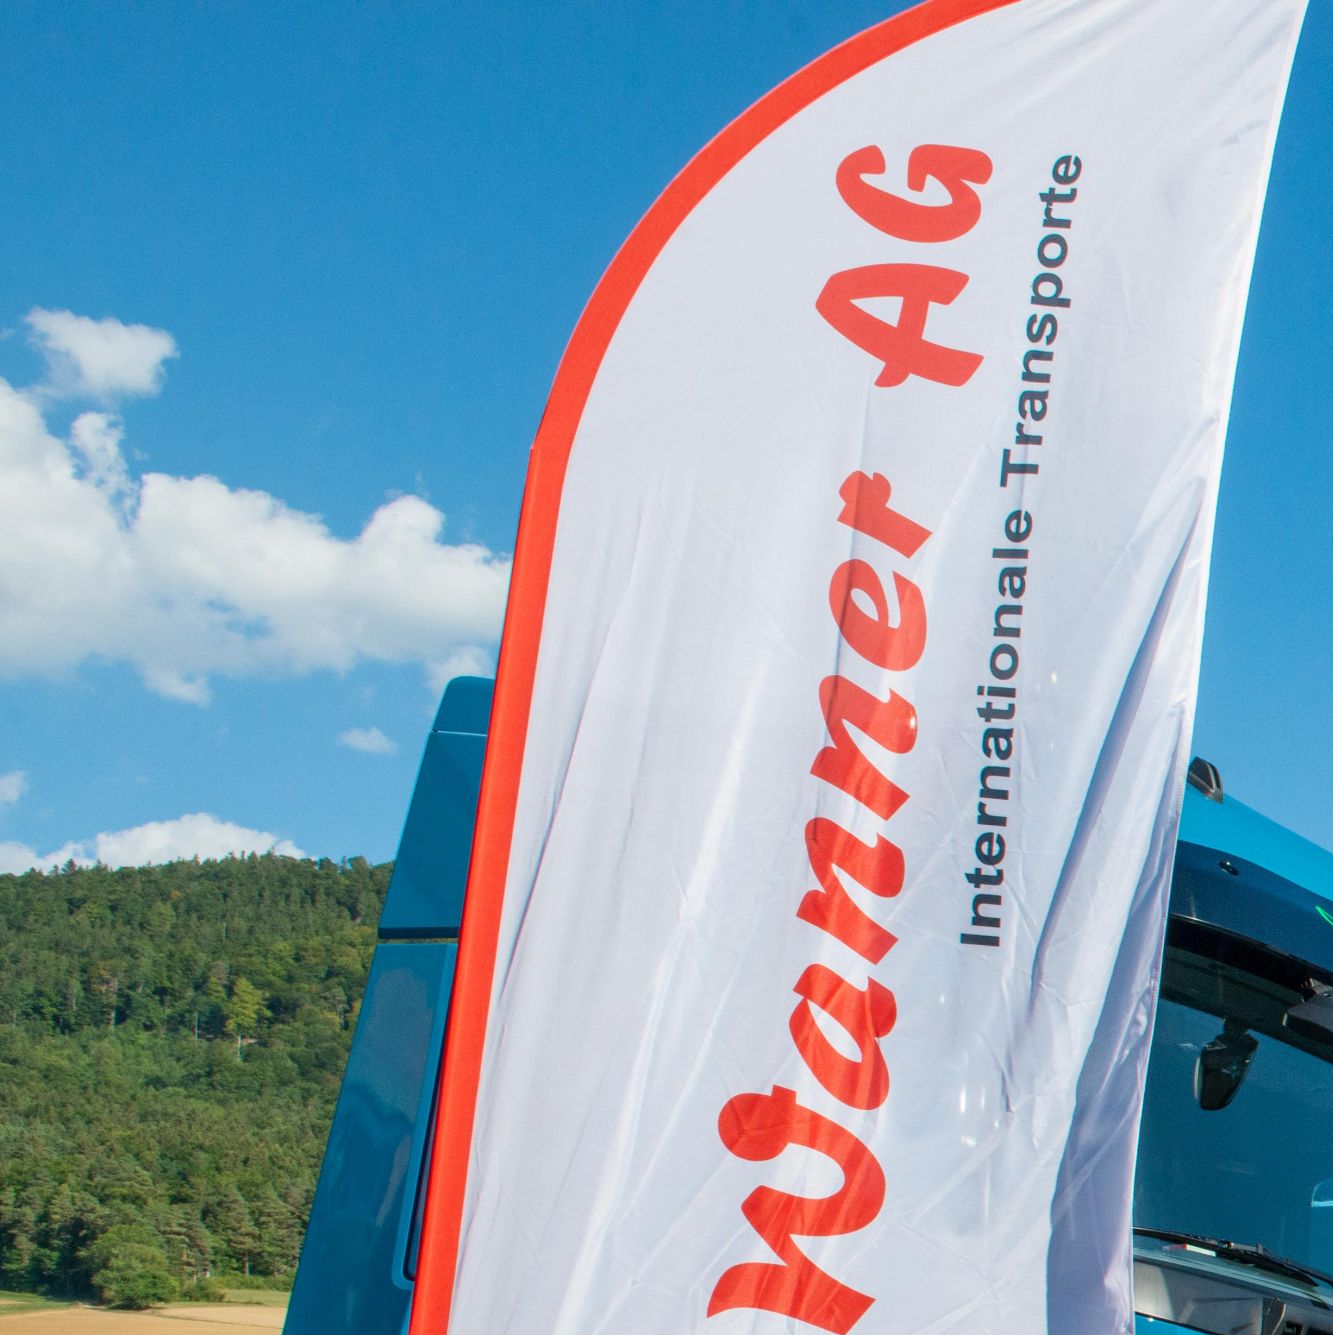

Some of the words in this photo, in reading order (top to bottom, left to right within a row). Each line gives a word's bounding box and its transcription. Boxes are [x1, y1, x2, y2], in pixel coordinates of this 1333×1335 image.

[815, 143, 993, 388] AG
[960, 509, 1032, 947] Internationale
[1000, 155, 1082, 488] Transporte
[706, 471, 931, 1335] Wanner
